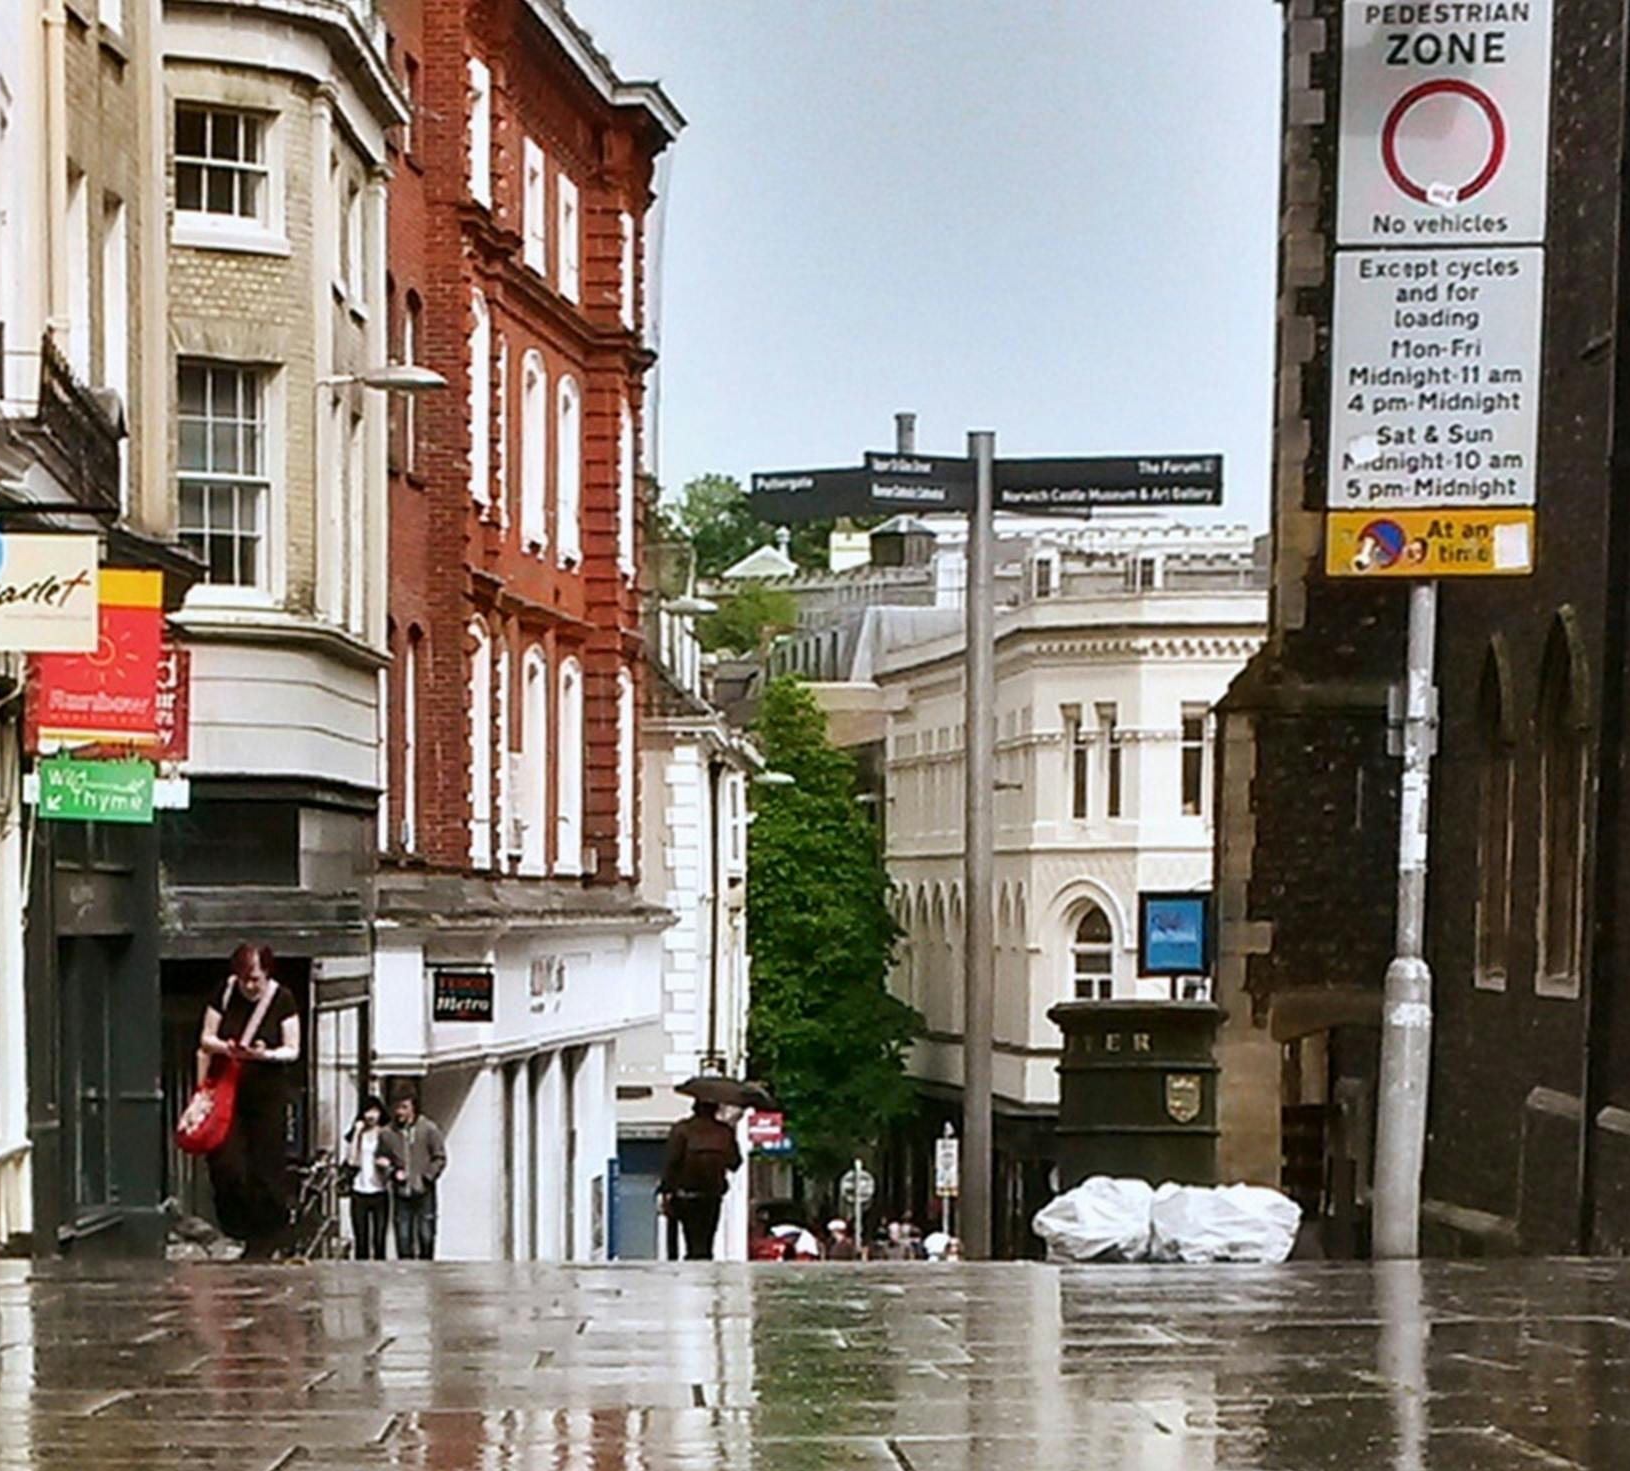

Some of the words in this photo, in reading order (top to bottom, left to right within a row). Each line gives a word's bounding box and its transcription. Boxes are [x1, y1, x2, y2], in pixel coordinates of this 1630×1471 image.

[1366, 3, 1529, 24] PEDESTRIAN
[1386, 32, 1505, 65] ZONE
[1373, 215, 1405, 233] No
[1414, 213, 1508, 233] vehicles
[1359, 258, 1439, 280] Except
[1446, 257, 1520, 280] cycles
[1396, 284, 1438, 303] and
[1447, 283, 1479, 301] for
[1394, 309, 1479, 330] loading
[1391, 338, 1481, 358] Mon-Fri
[1349, 366, 1480, 388] Midnight-11
[1488, 368, 1522, 384] am
[1347, 394, 1364, 411] 4
[1372, 392, 1521, 414] pm-Midnight
[1377, 425, 1416, 445] Sat
[1424, 425, 1439, 444] &
[1448, 424, 1494, 444] Sun
[1138, 461, 1159, 474] The
[1162, 460, 1201, 474] Forum
[1488, 453, 1523, 469] am
[1002, 489, 1048, 502] Norwich
[1049, 488, 1086, 501] Castle
[1087, 488, 1137, 501] Museum
[1139, 487, 1149, 500] &
[1151, 487, 1169, 500] Art
[1172, 487, 1214, 502] Gallery
[1347, 478, 1361, 498] 5
[1368, 478, 1517, 500] pm-Midnight
[1427, 520, 1454, 538] At
[1461, 523, 1493, 540] an
[49, 689, 151, 714] Rainbow
[71, 790, 143, 812] Thyme
[436, 996, 490, 1012] Metro
